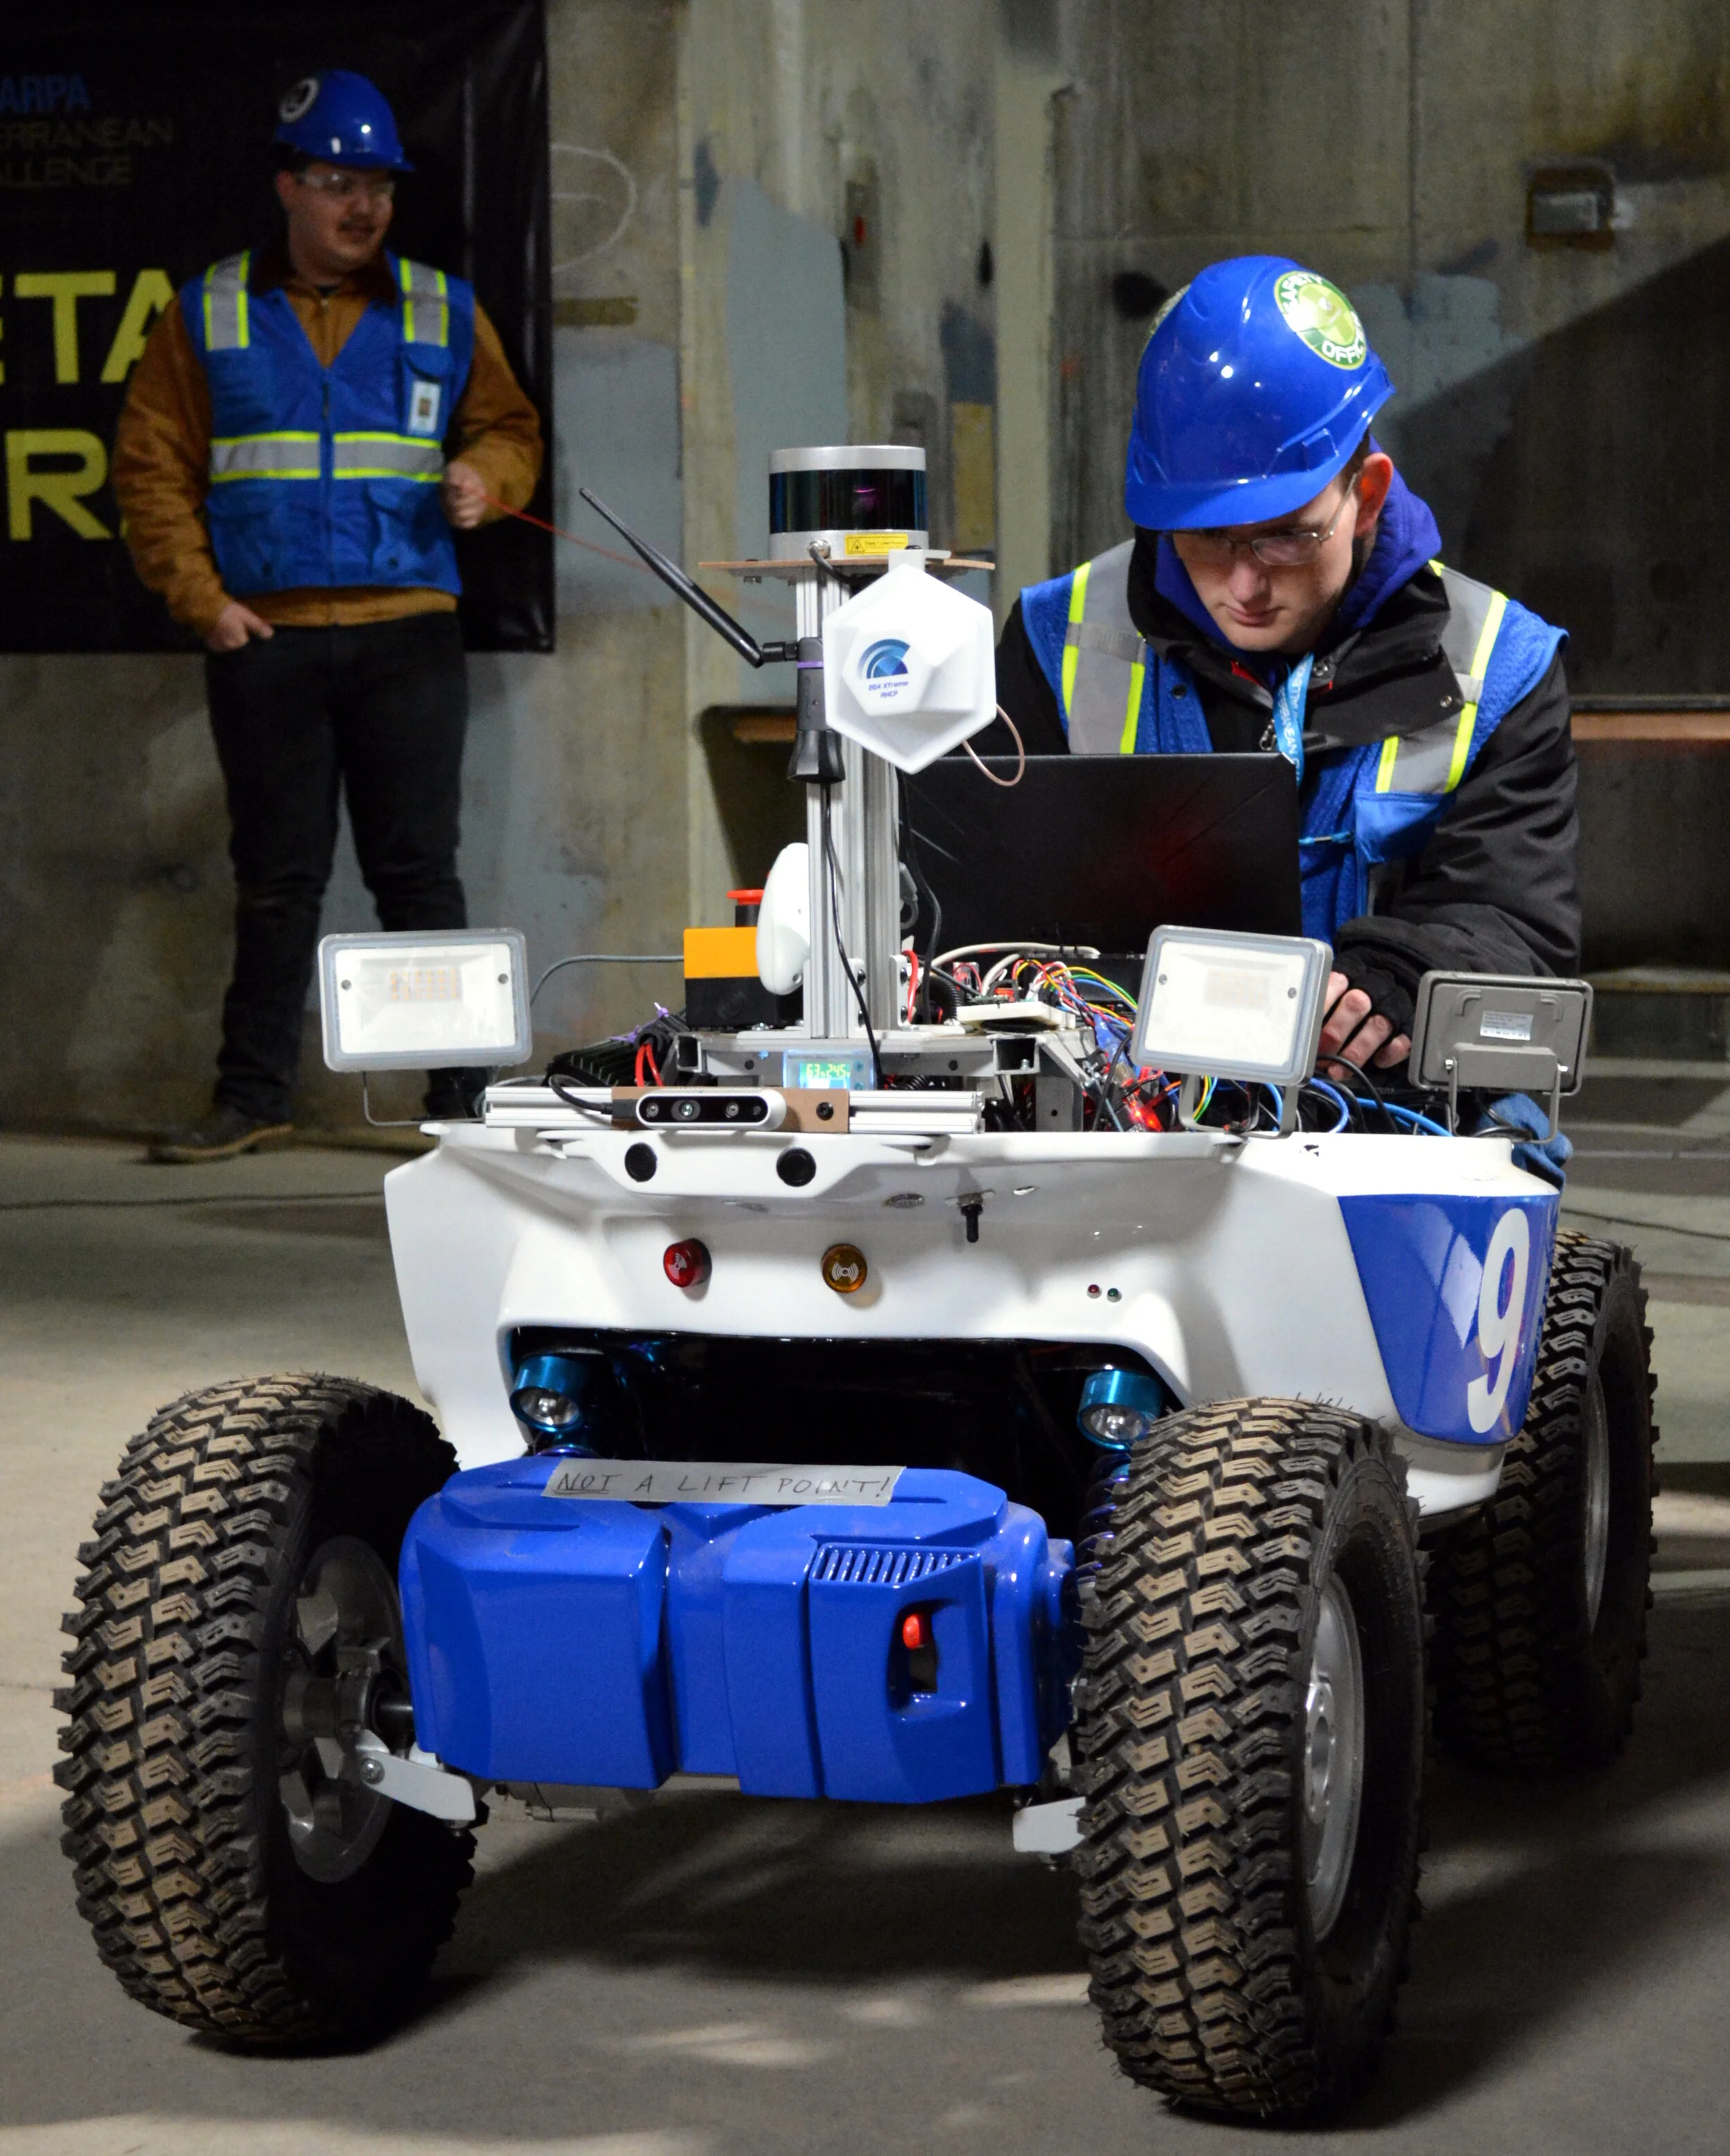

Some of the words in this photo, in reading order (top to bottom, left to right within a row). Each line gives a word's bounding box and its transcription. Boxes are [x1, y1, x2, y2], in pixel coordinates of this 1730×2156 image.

[0, 269, 175, 384] TA
[1468, 1208, 1530, 1433] 9
[554, 1473, 623, 1494] NOT
[634, 1474, 654, 1493] A
[677, 1474, 767, 1493] LIFT
[777, 1476, 890, 1498] POINT!
